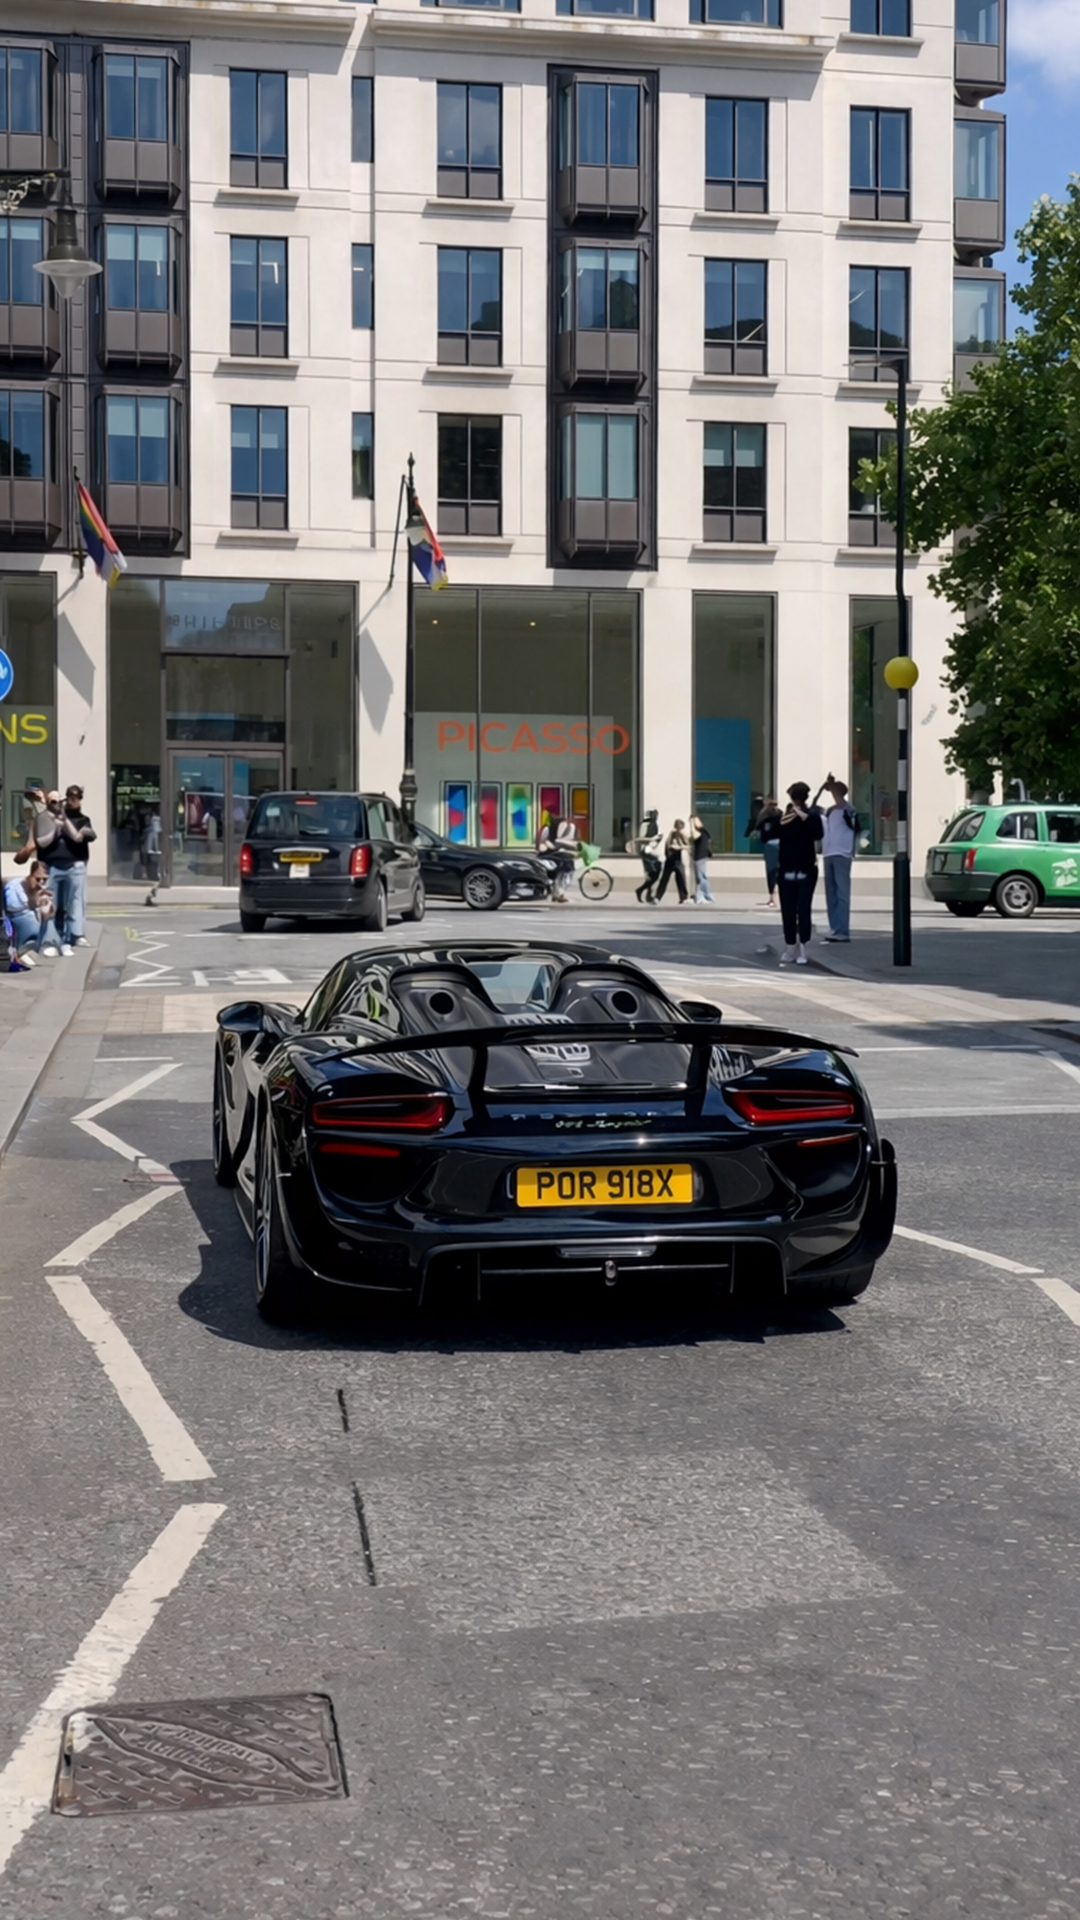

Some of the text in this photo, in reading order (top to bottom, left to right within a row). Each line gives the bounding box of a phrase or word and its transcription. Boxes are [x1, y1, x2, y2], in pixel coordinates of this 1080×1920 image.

[437, 720, 631, 755] PICASSO
[536, 1168, 674, 1200] POR 918X
